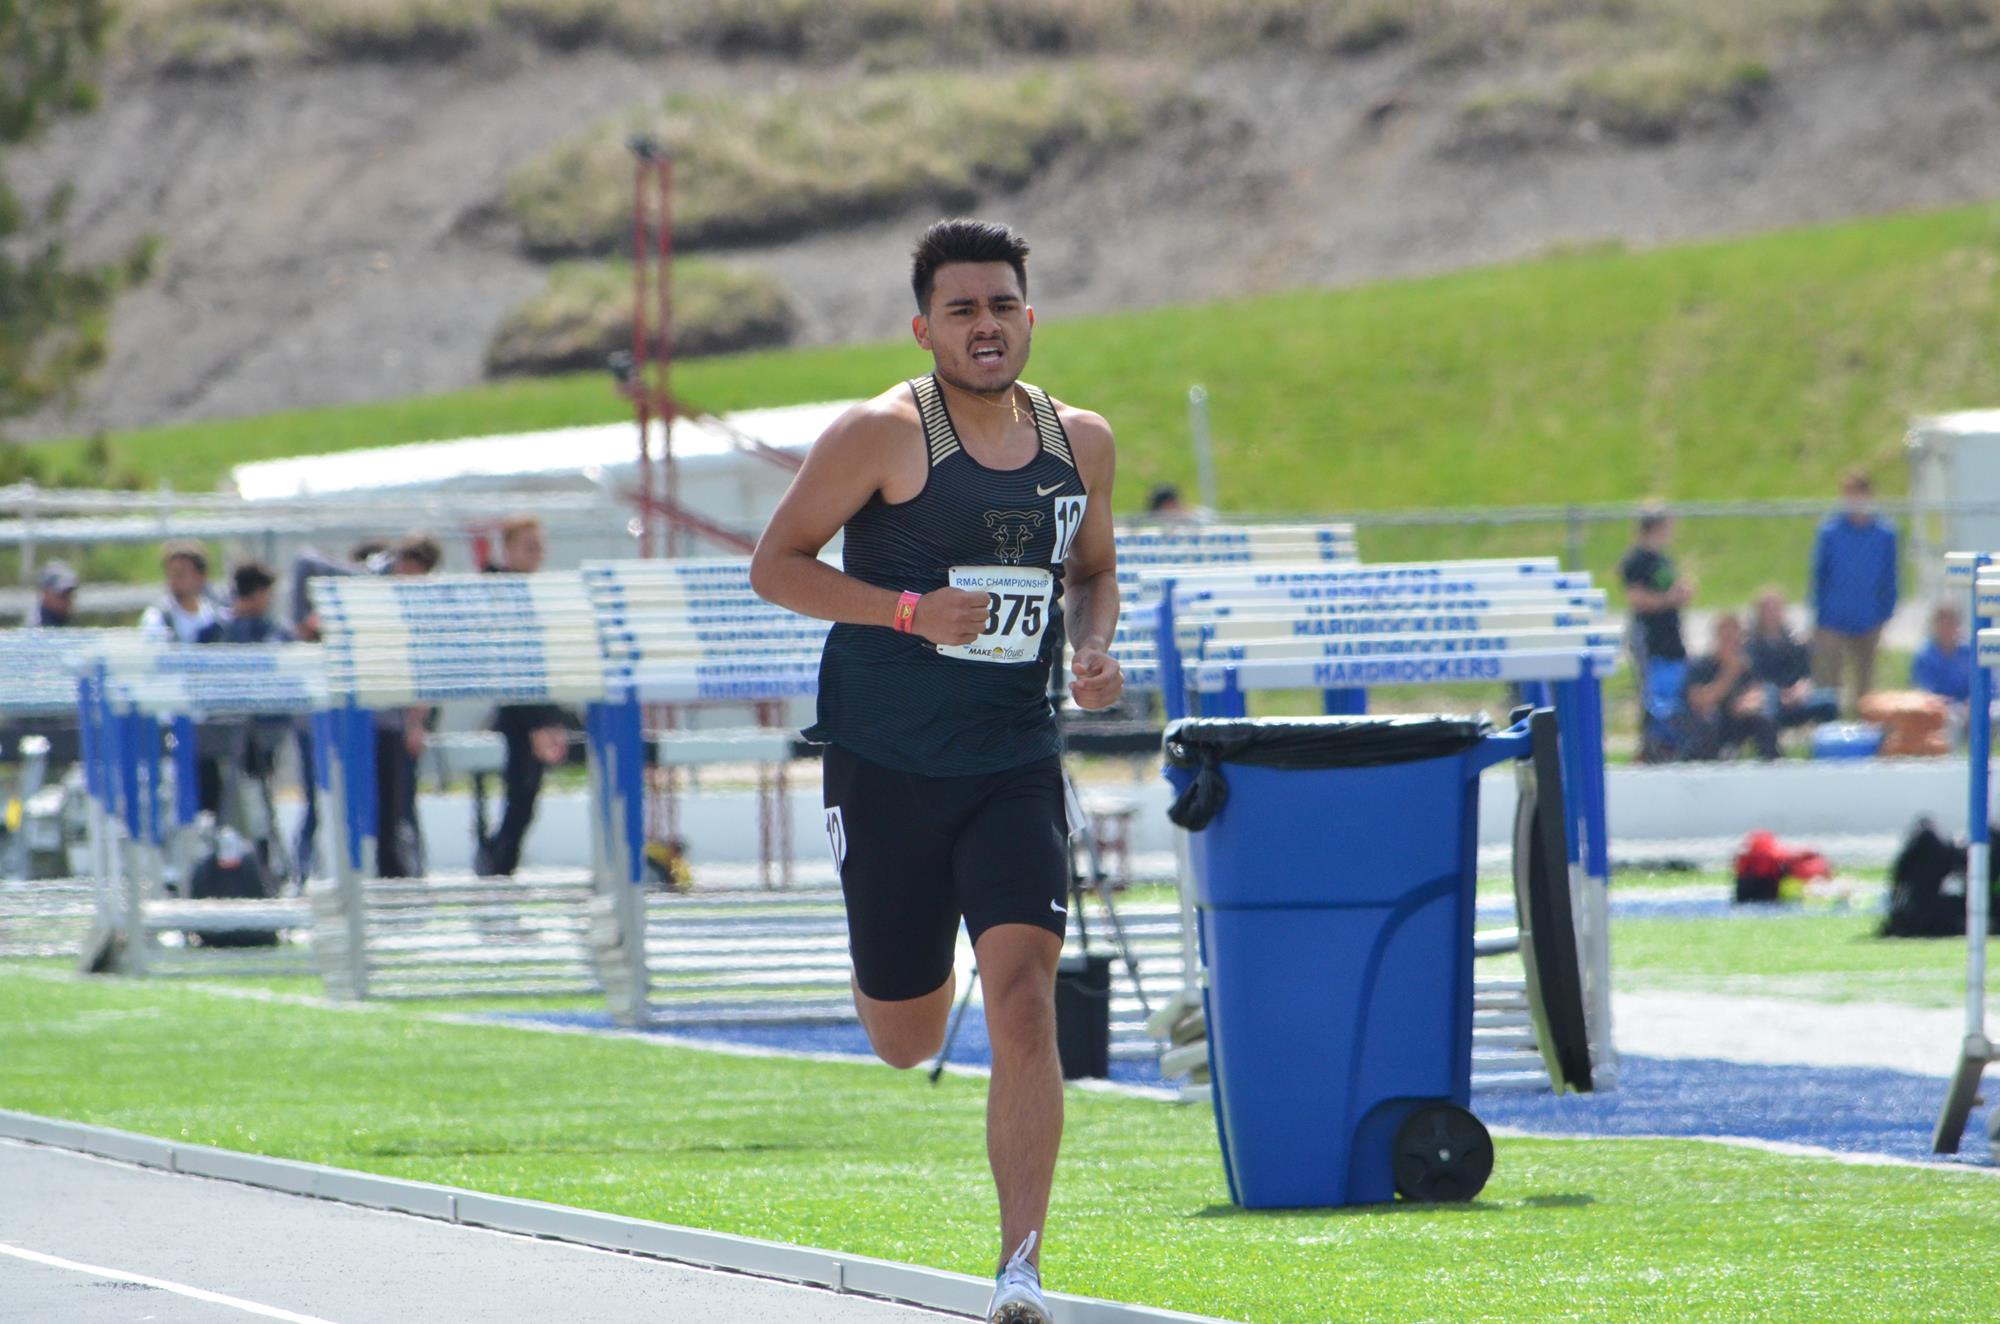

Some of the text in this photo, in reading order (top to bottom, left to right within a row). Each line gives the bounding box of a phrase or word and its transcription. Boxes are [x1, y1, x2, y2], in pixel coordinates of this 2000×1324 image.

[956, 577, 1049, 588] RMAC CHAMPIONSHIP
[968, 647, 993, 657] MAKE
[1313, 656, 1501, 685] HARDROCKERS
